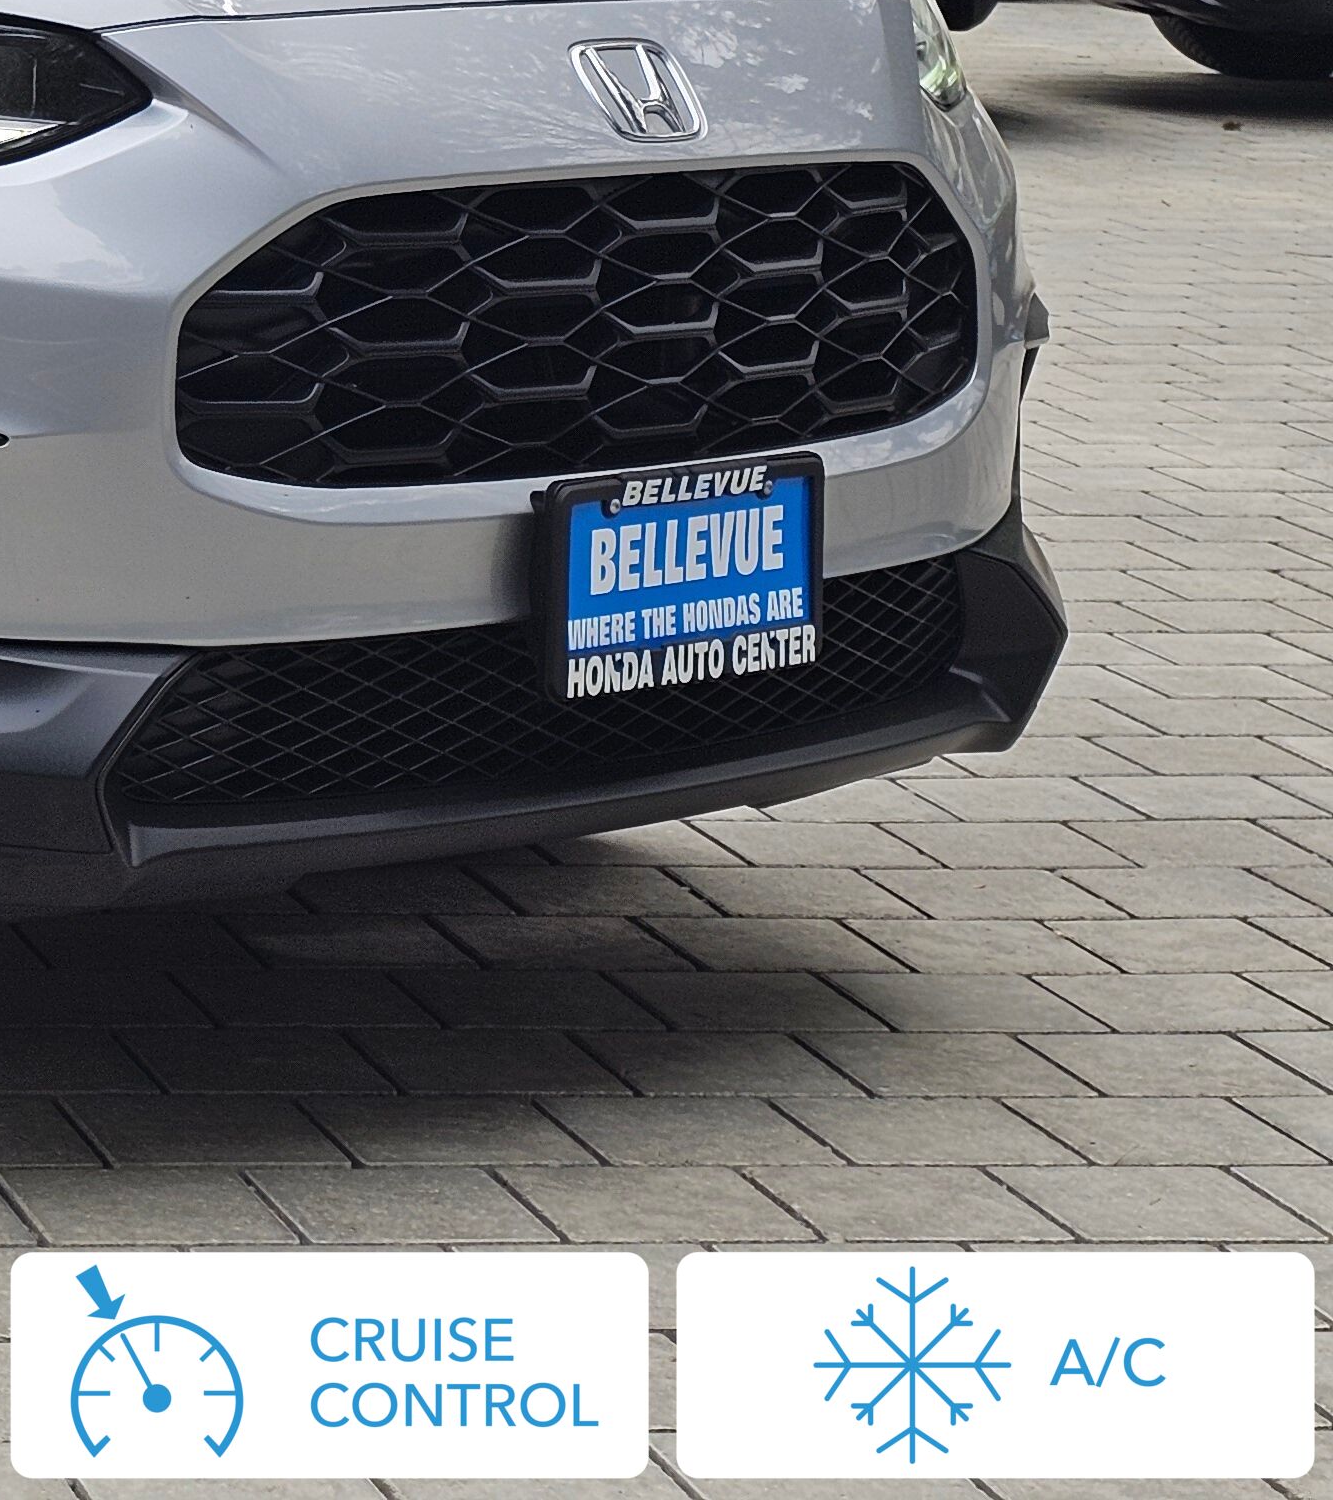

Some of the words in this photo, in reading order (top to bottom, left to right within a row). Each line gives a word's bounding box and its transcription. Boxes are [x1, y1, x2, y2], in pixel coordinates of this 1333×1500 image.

[622, 465, 768, 507] BELLEVUE
[590, 504, 784, 596] BELLEVUE
[567, 610, 636, 651] WHERE
[641, 604, 677, 640] THE
[682, 592, 762, 634] HONDAS
[766, 586, 804, 621] ARE
[566, 648, 655, 699] HONDA
[660, 638, 726, 687] AUTO
[731, 624, 816, 676] CENTER
